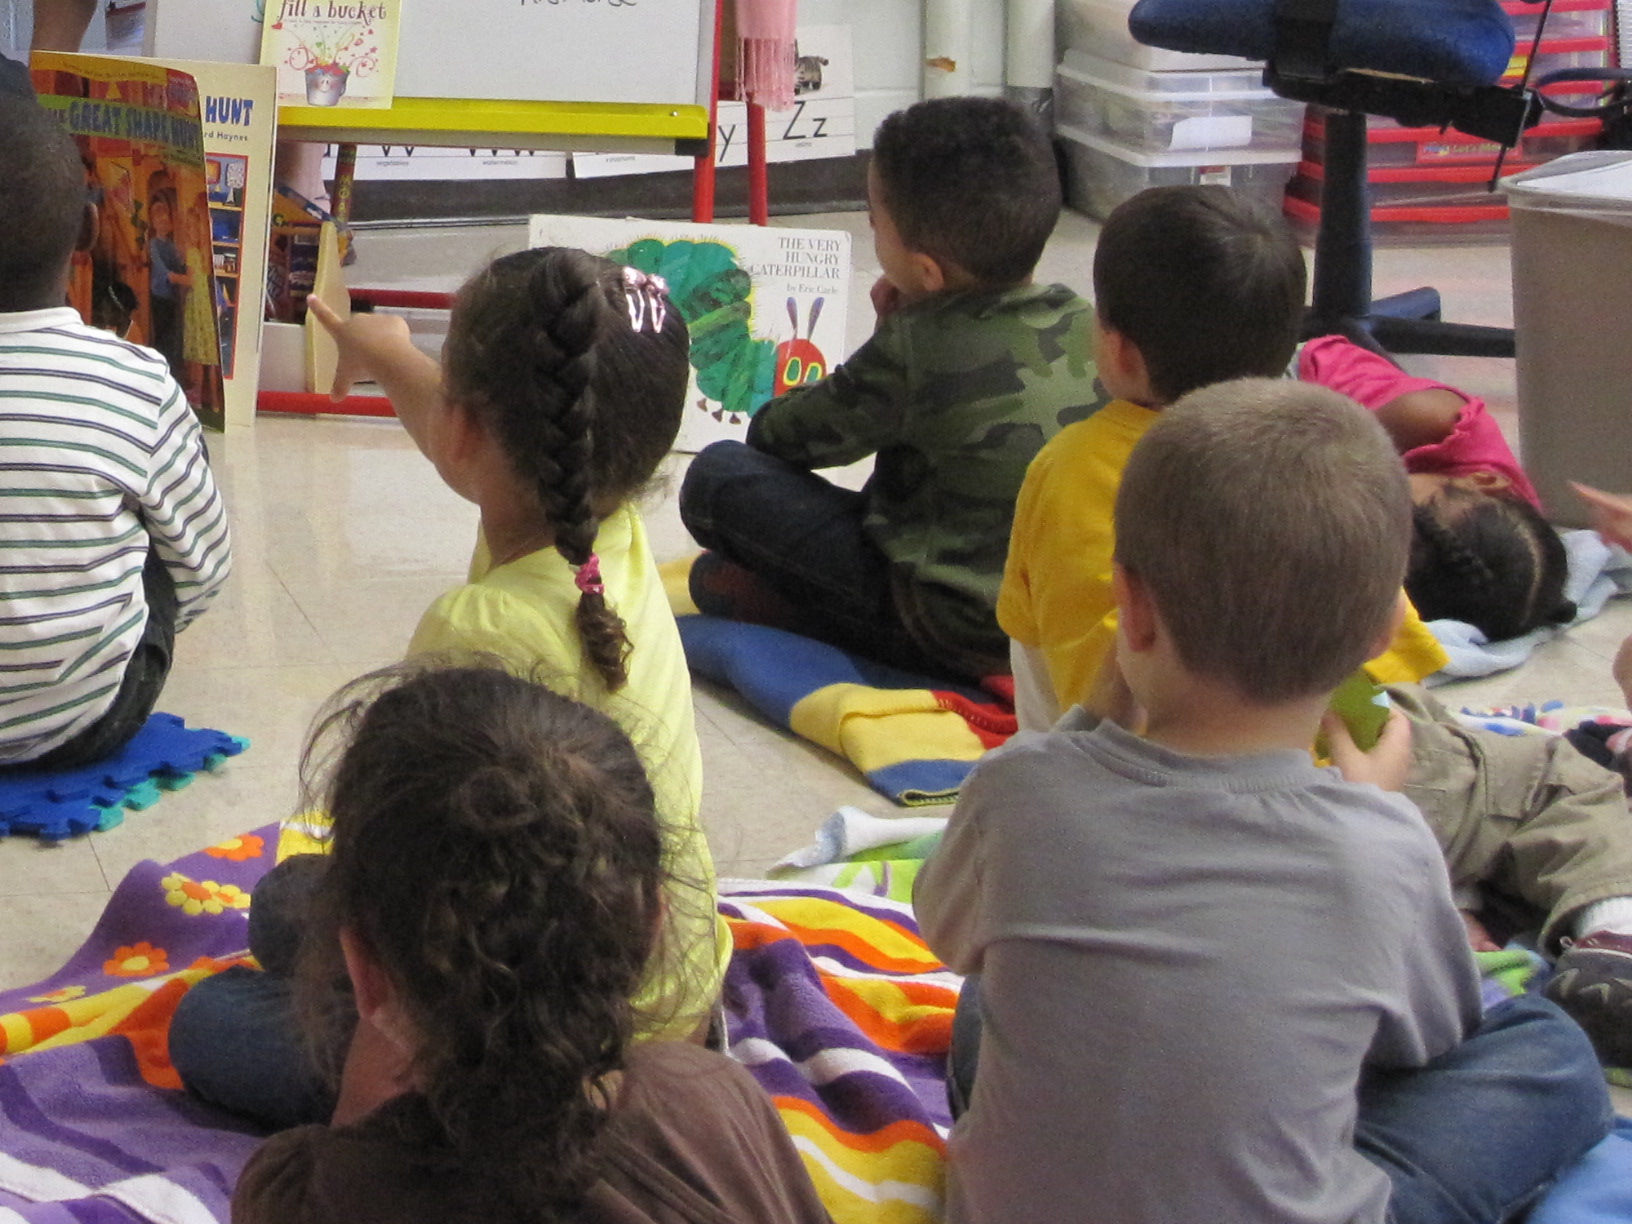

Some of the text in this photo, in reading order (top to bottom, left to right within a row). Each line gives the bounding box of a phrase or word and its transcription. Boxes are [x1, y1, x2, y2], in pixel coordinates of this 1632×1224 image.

[312, 5, 321, 18] a
[328, 0, 387, 26] bucket
[204, 95, 254, 127] HUNT
[783, 100, 828, 140] Zz
[216, 132, 249, 143] Haynes
[779, 237, 841, 252] THE VERY
[786, 251, 840, 266] HUNGRY
[750, 264, 840, 279] CATERPILLAR
[786, 282, 796, 292] by
